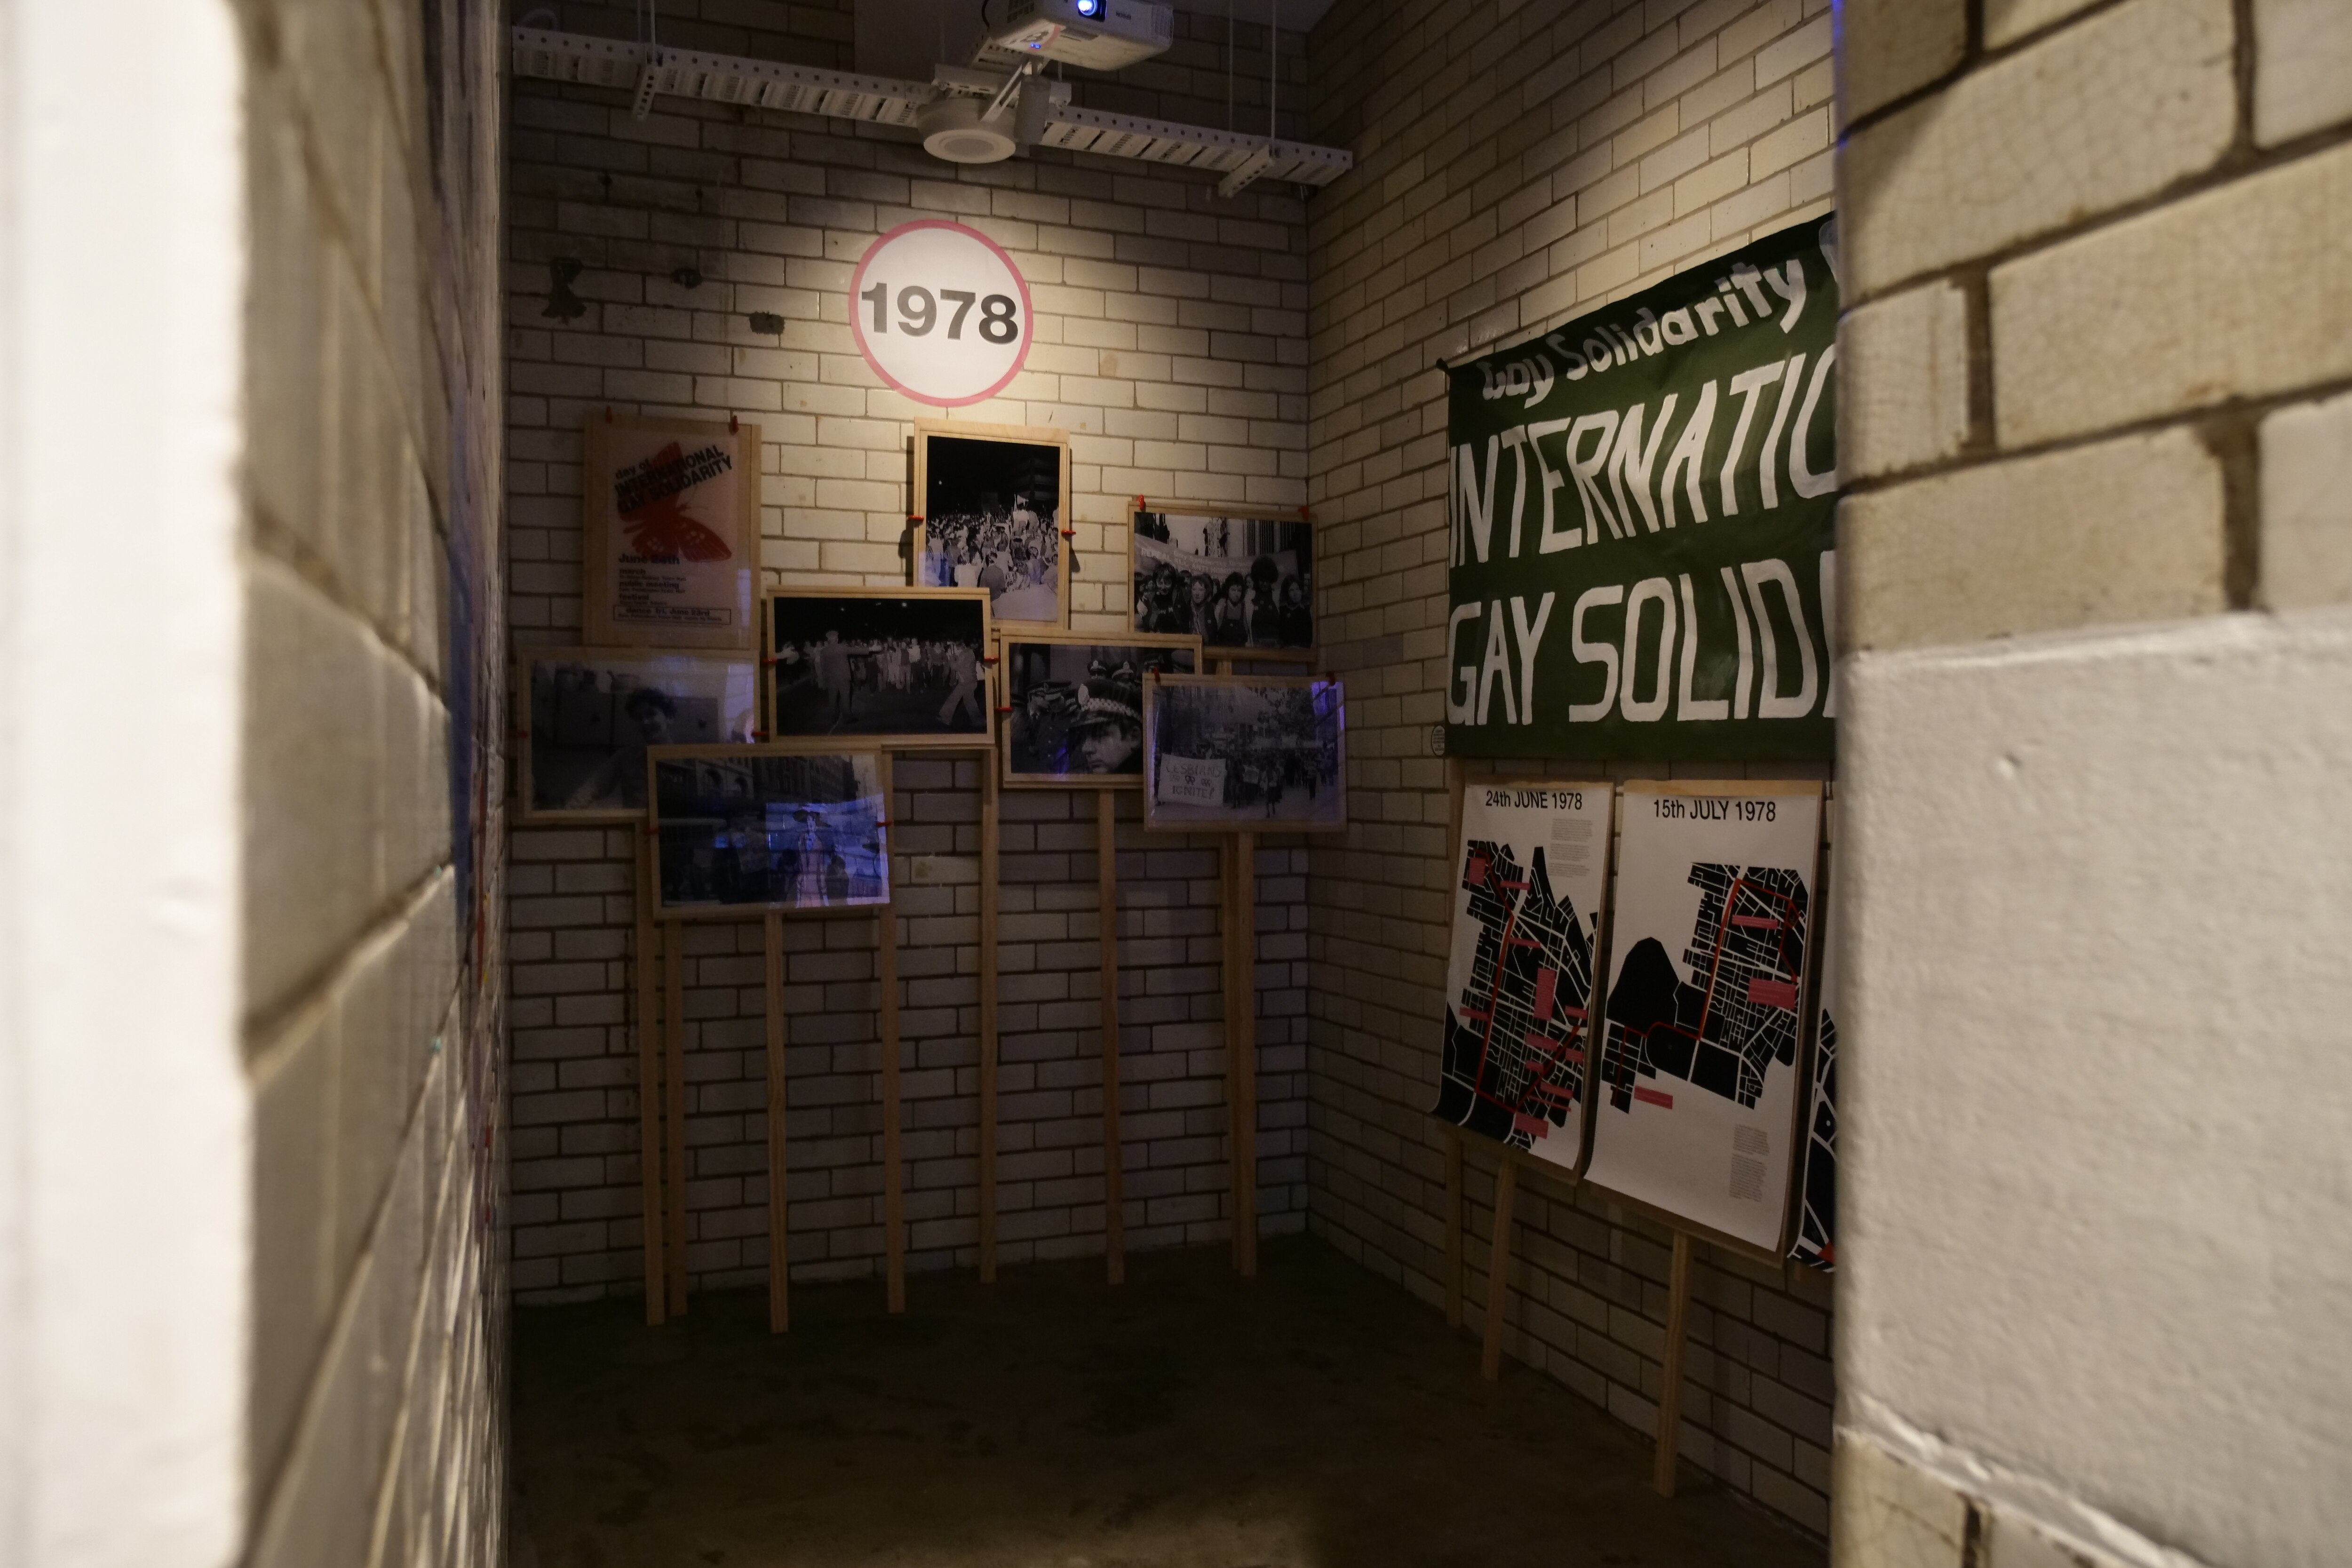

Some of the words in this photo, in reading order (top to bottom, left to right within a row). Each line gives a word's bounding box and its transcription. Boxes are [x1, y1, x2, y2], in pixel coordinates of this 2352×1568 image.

[861, 282, 1018, 345] 1978
[1476, 353, 1554, 409] Gay
[1546, 258, 1807, 381] Solidarity
[615, 466, 636, 479] day
[639, 458, 650, 470] of
[615, 444, 723, 497] INTERNATIONAL
[618, 491, 646, 513] GAY
[648, 455, 732, 501] SOLIDARITY
[619, 553, 648, 564] June
[1448, 591, 1555, 725] GAY
[1569, 550, 1836, 722] SOLID
[1486, 790, 1510, 807] 24th
[1515, 791, 1548, 808] JUNE
[1552, 792, 1582, 810] 1978
[1654, 799, 1685, 818] 15th
[1690, 800, 1729, 820] JULY
[1736, 801, 1775, 821] 1978
